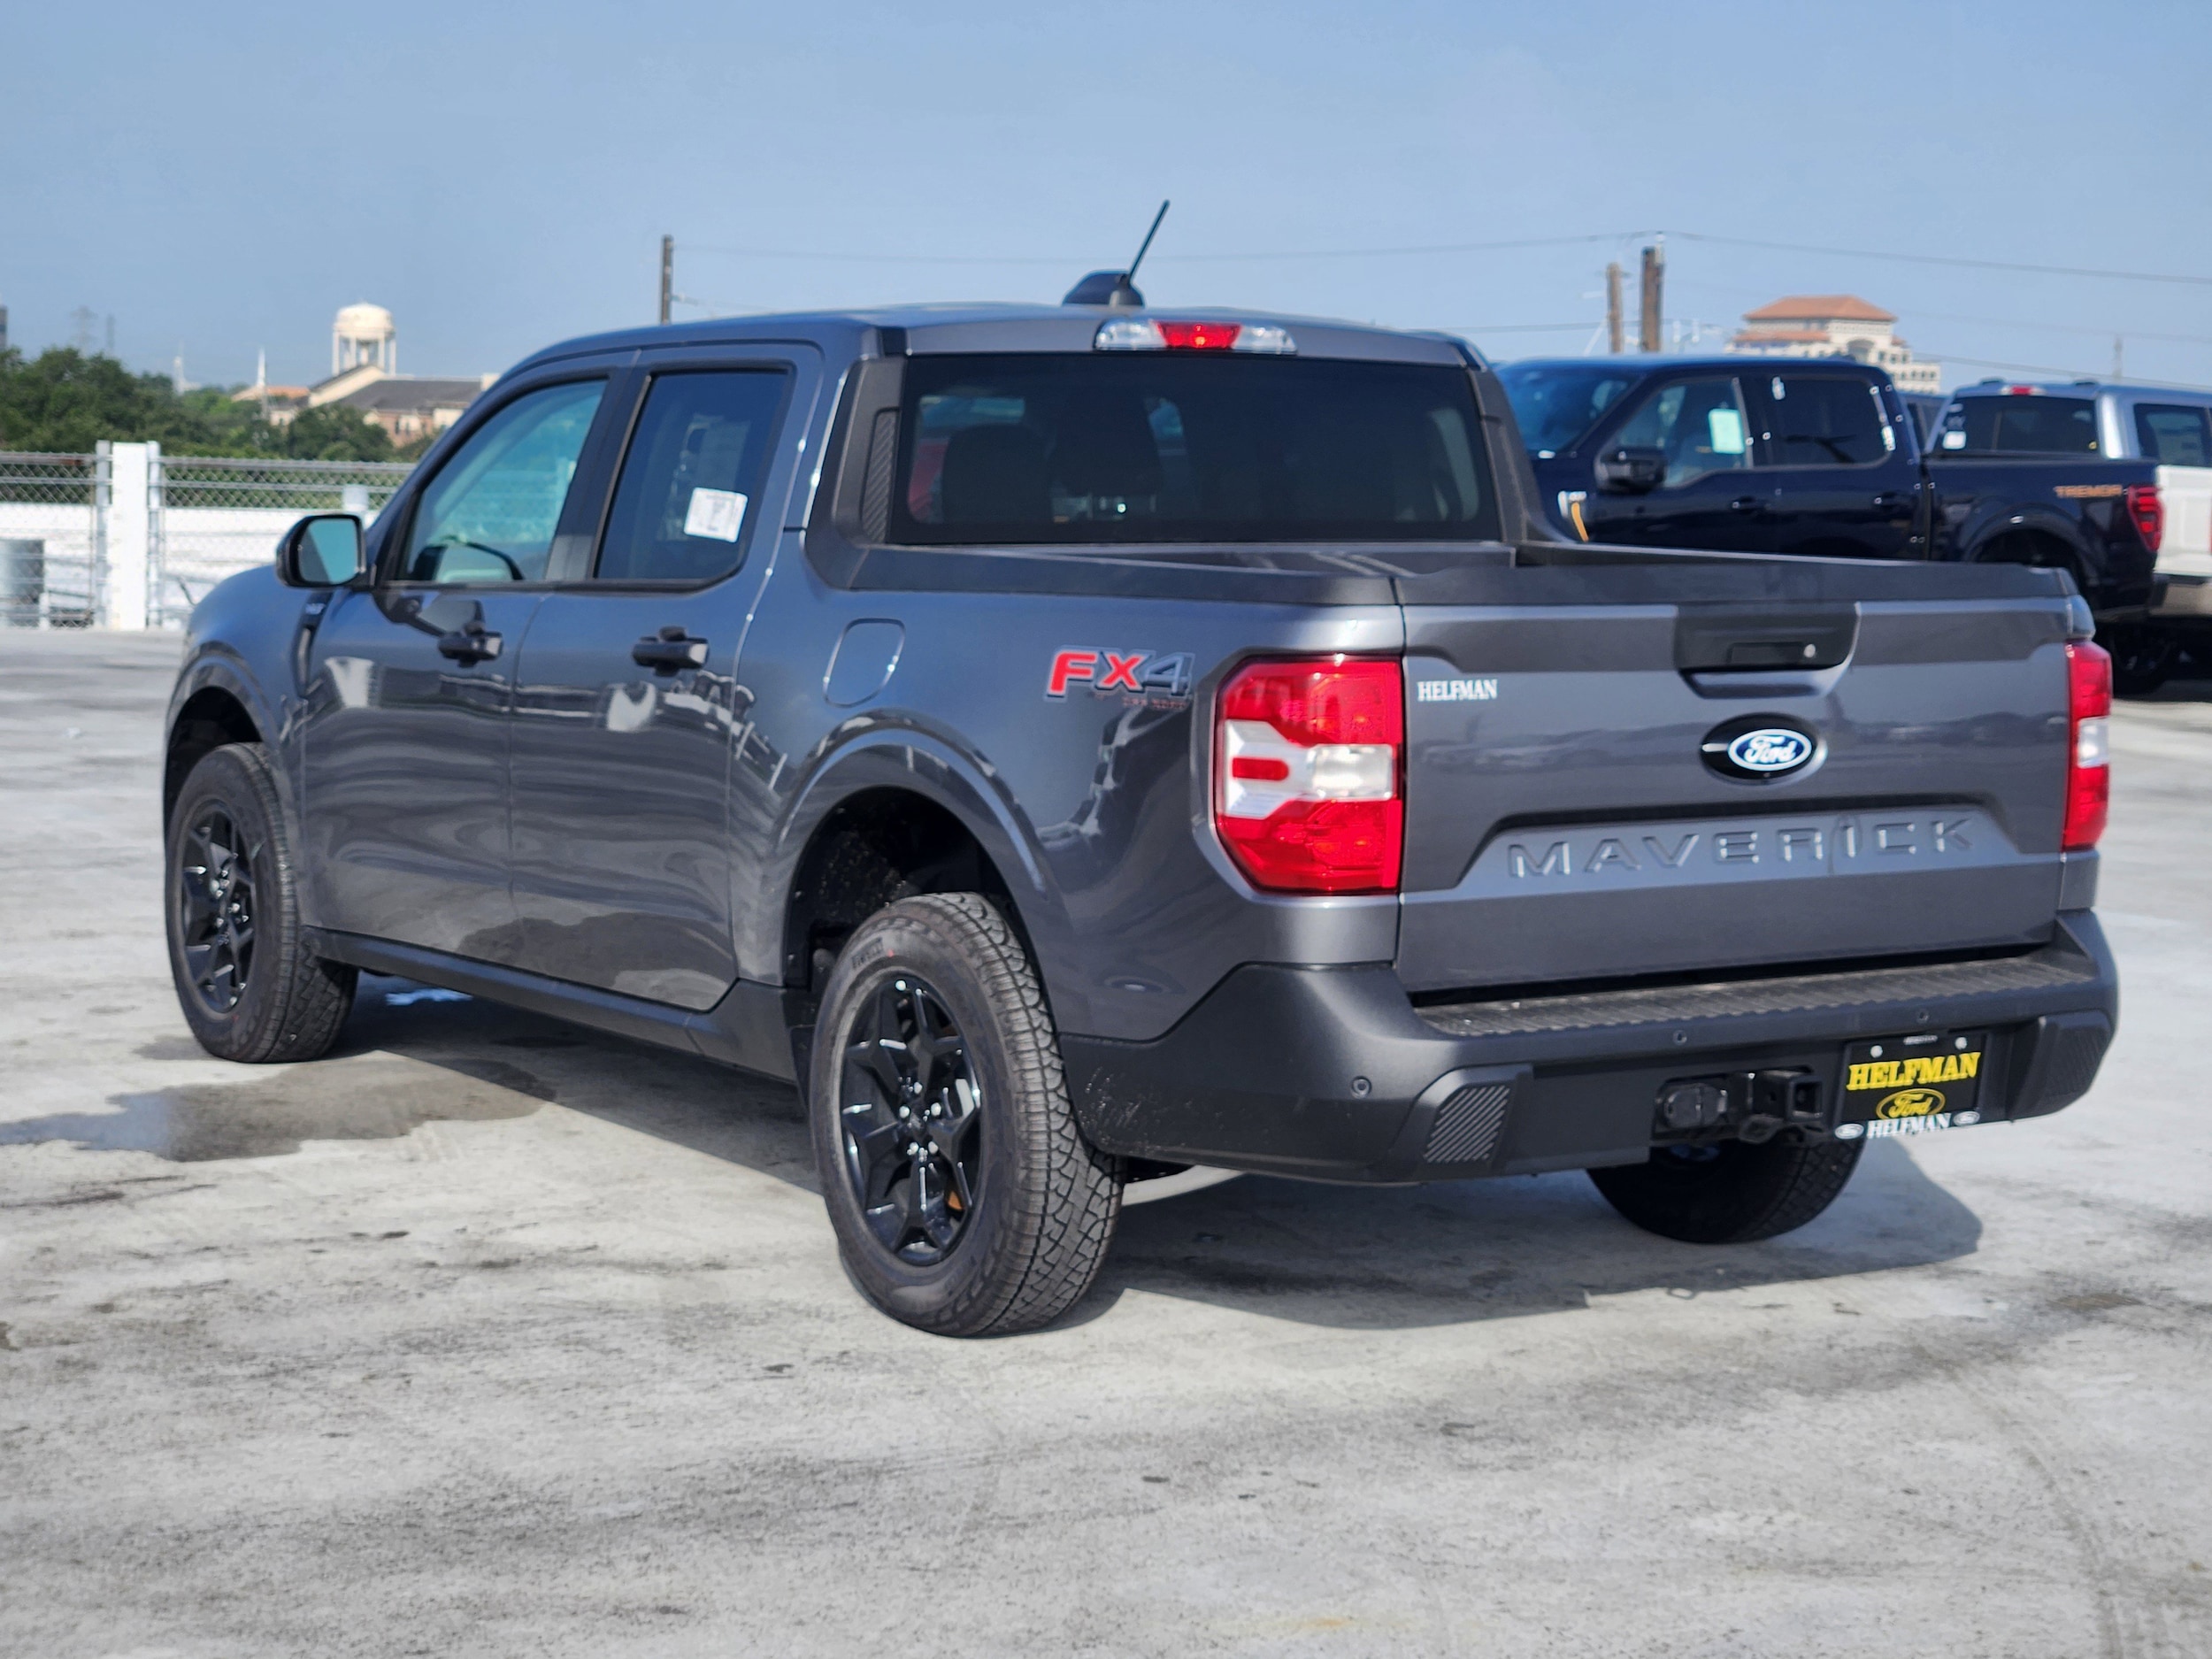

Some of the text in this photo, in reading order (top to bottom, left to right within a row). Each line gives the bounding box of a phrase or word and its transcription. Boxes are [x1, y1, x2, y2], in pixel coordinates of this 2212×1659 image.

[1046, 649, 1194, 696] FX4
[1417, 679, 1498, 702] HELFMAN
[1744, 735, 1797, 764] Ford
[1508, 817, 1973, 879] MAVERICK
[1847, 1052, 1981, 1090] HELFMAN
[1888, 1093, 1933, 1118] Ford
[1868, 1113, 1952, 1139] HELFMAN
